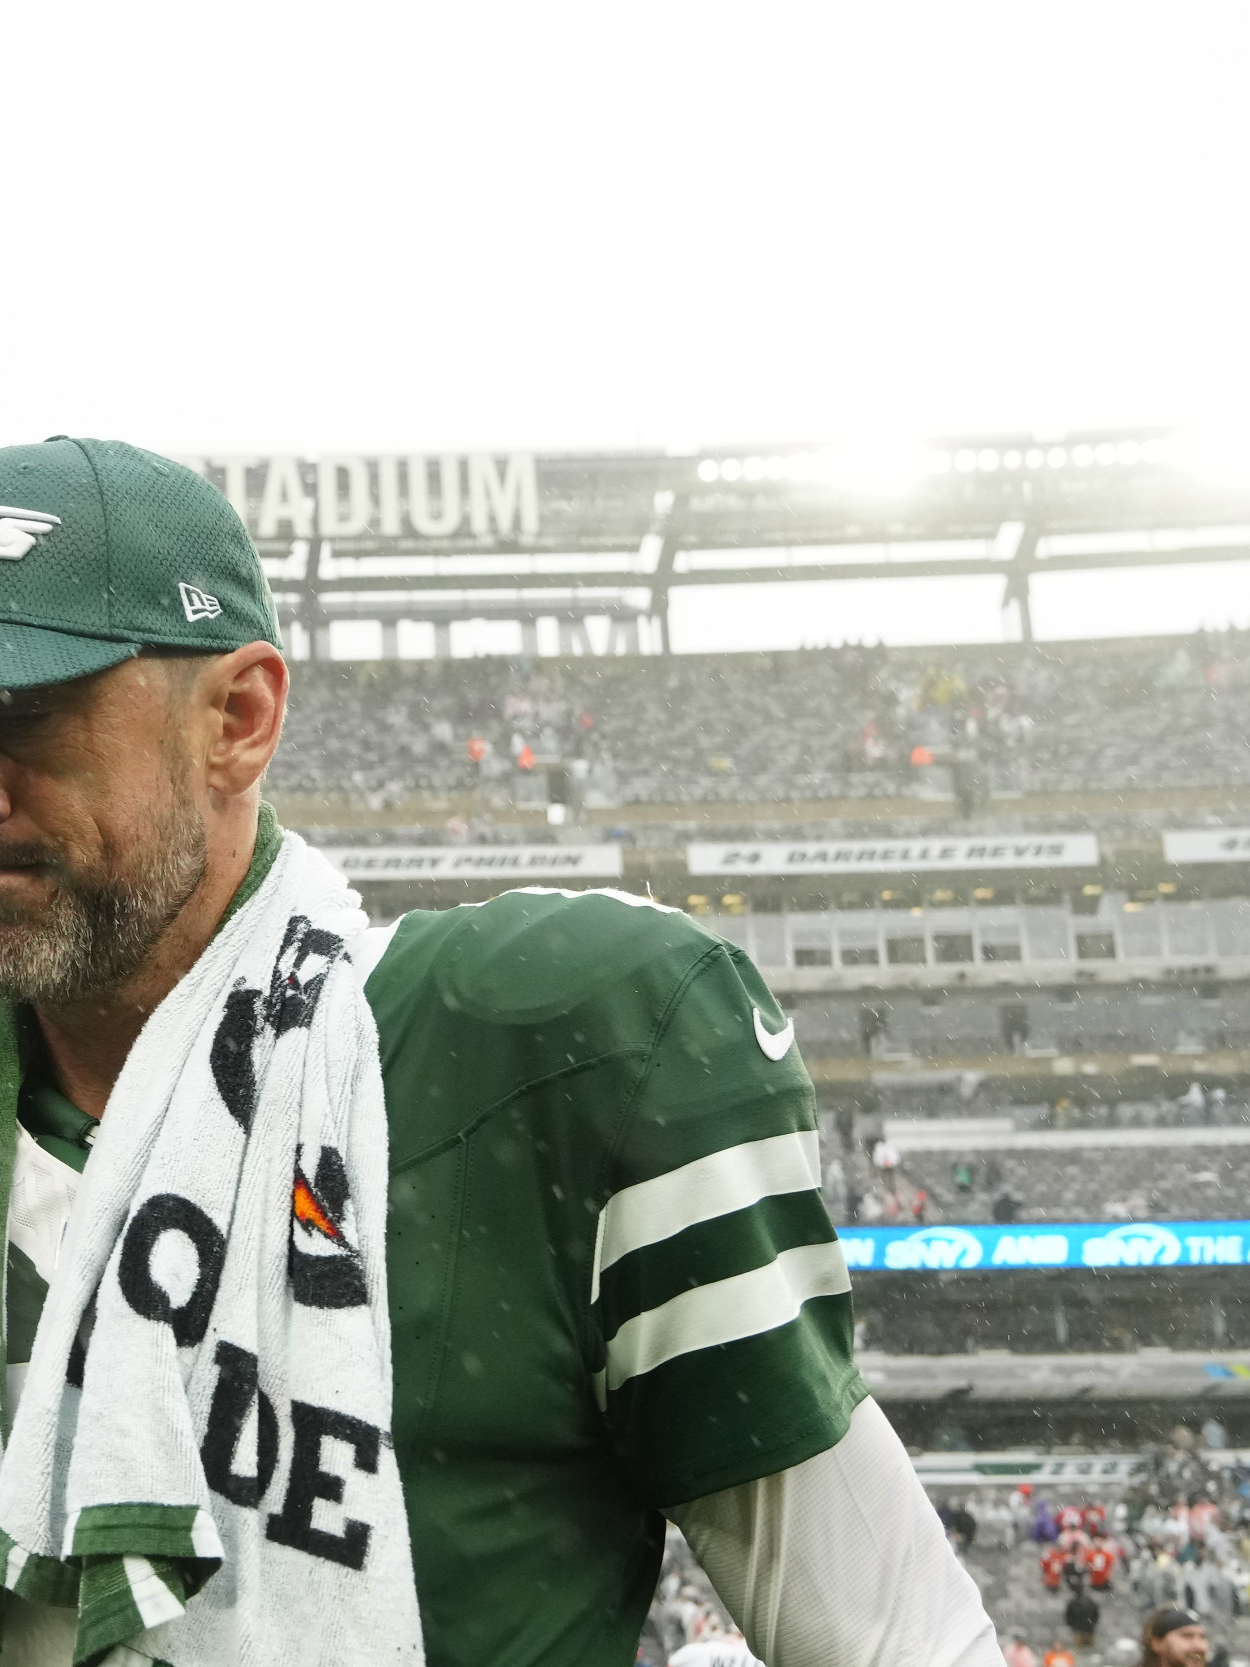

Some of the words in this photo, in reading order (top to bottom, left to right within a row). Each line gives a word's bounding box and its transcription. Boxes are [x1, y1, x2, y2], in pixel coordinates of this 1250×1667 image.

[188, 452, 538, 537] TADIUM
[452, 853, 583, 869] PHILBIN
[785, 846, 956, 865] DARRELLE
[965, 842, 1065, 861] REVIS
[1184, 1235, 1244, 1265] THE
